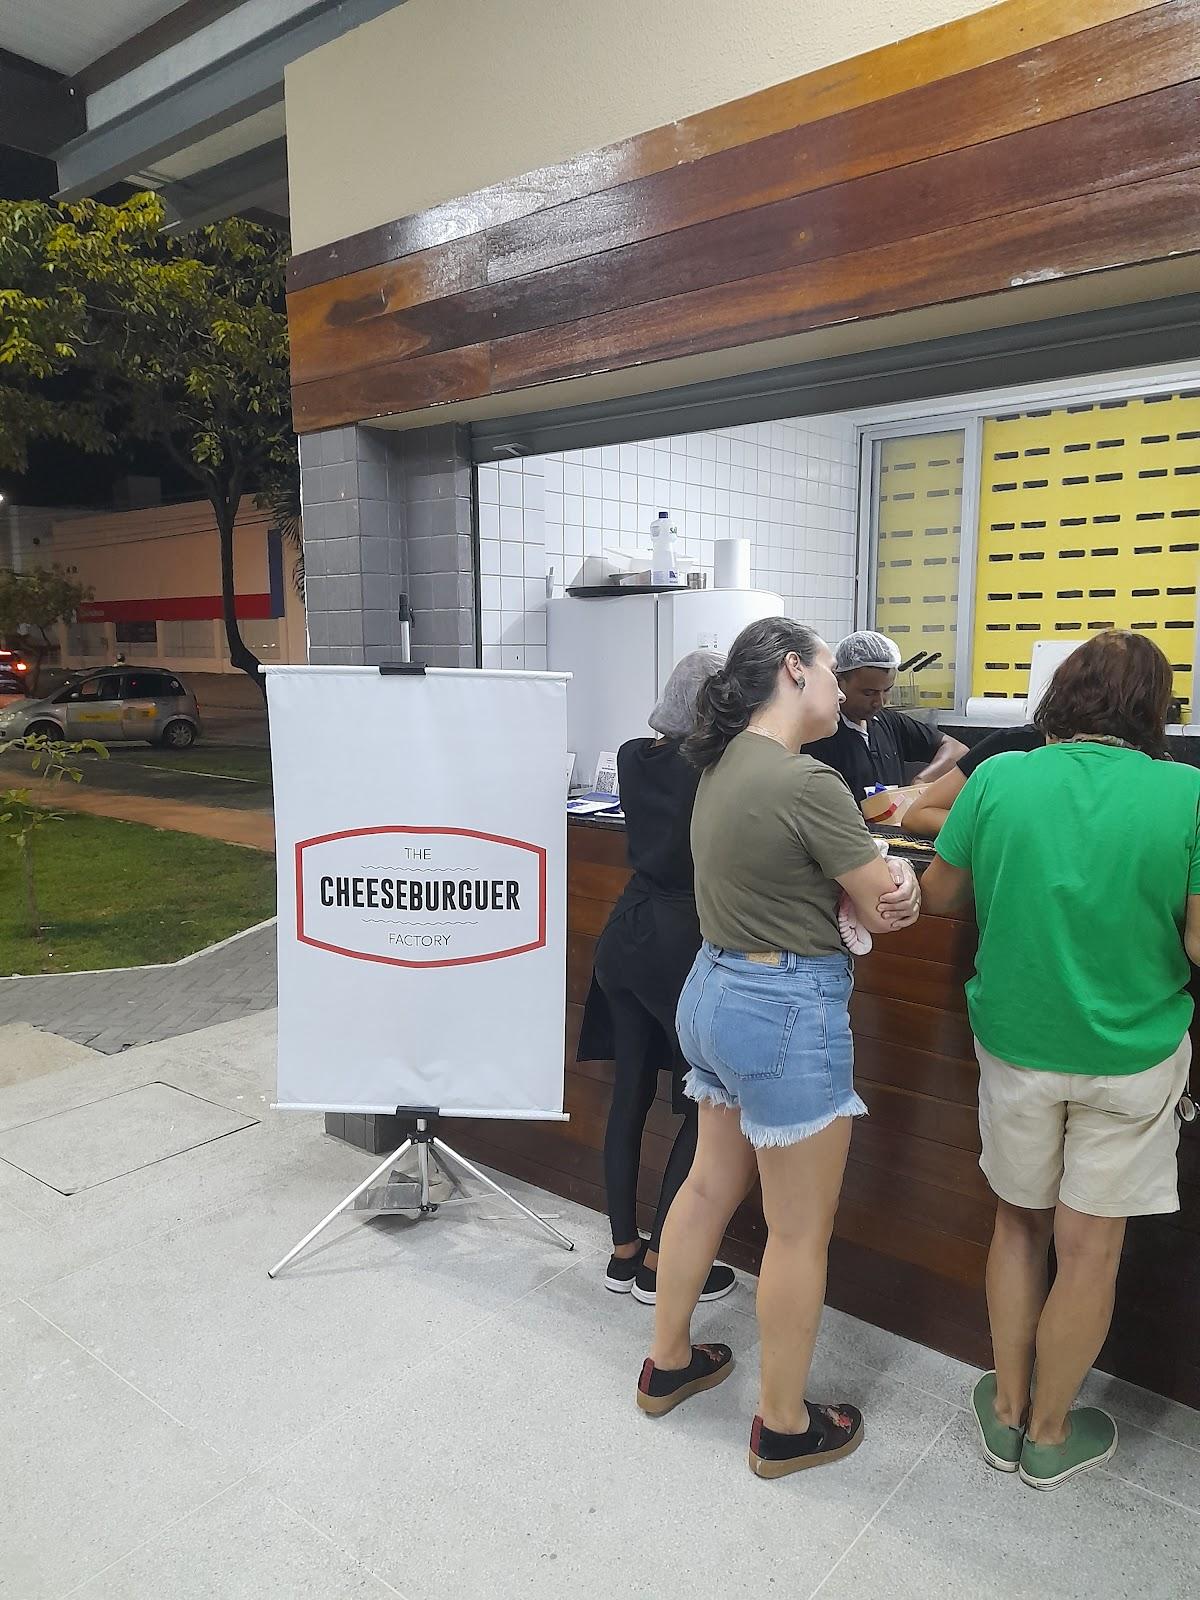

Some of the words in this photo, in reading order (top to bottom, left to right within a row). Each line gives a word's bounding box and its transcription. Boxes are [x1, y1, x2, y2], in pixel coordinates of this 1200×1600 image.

[404, 847, 432, 860] THE
[320, 876, 521, 911] CHEESEBURGUER
[388, 933, 451, 947] FACTORY
